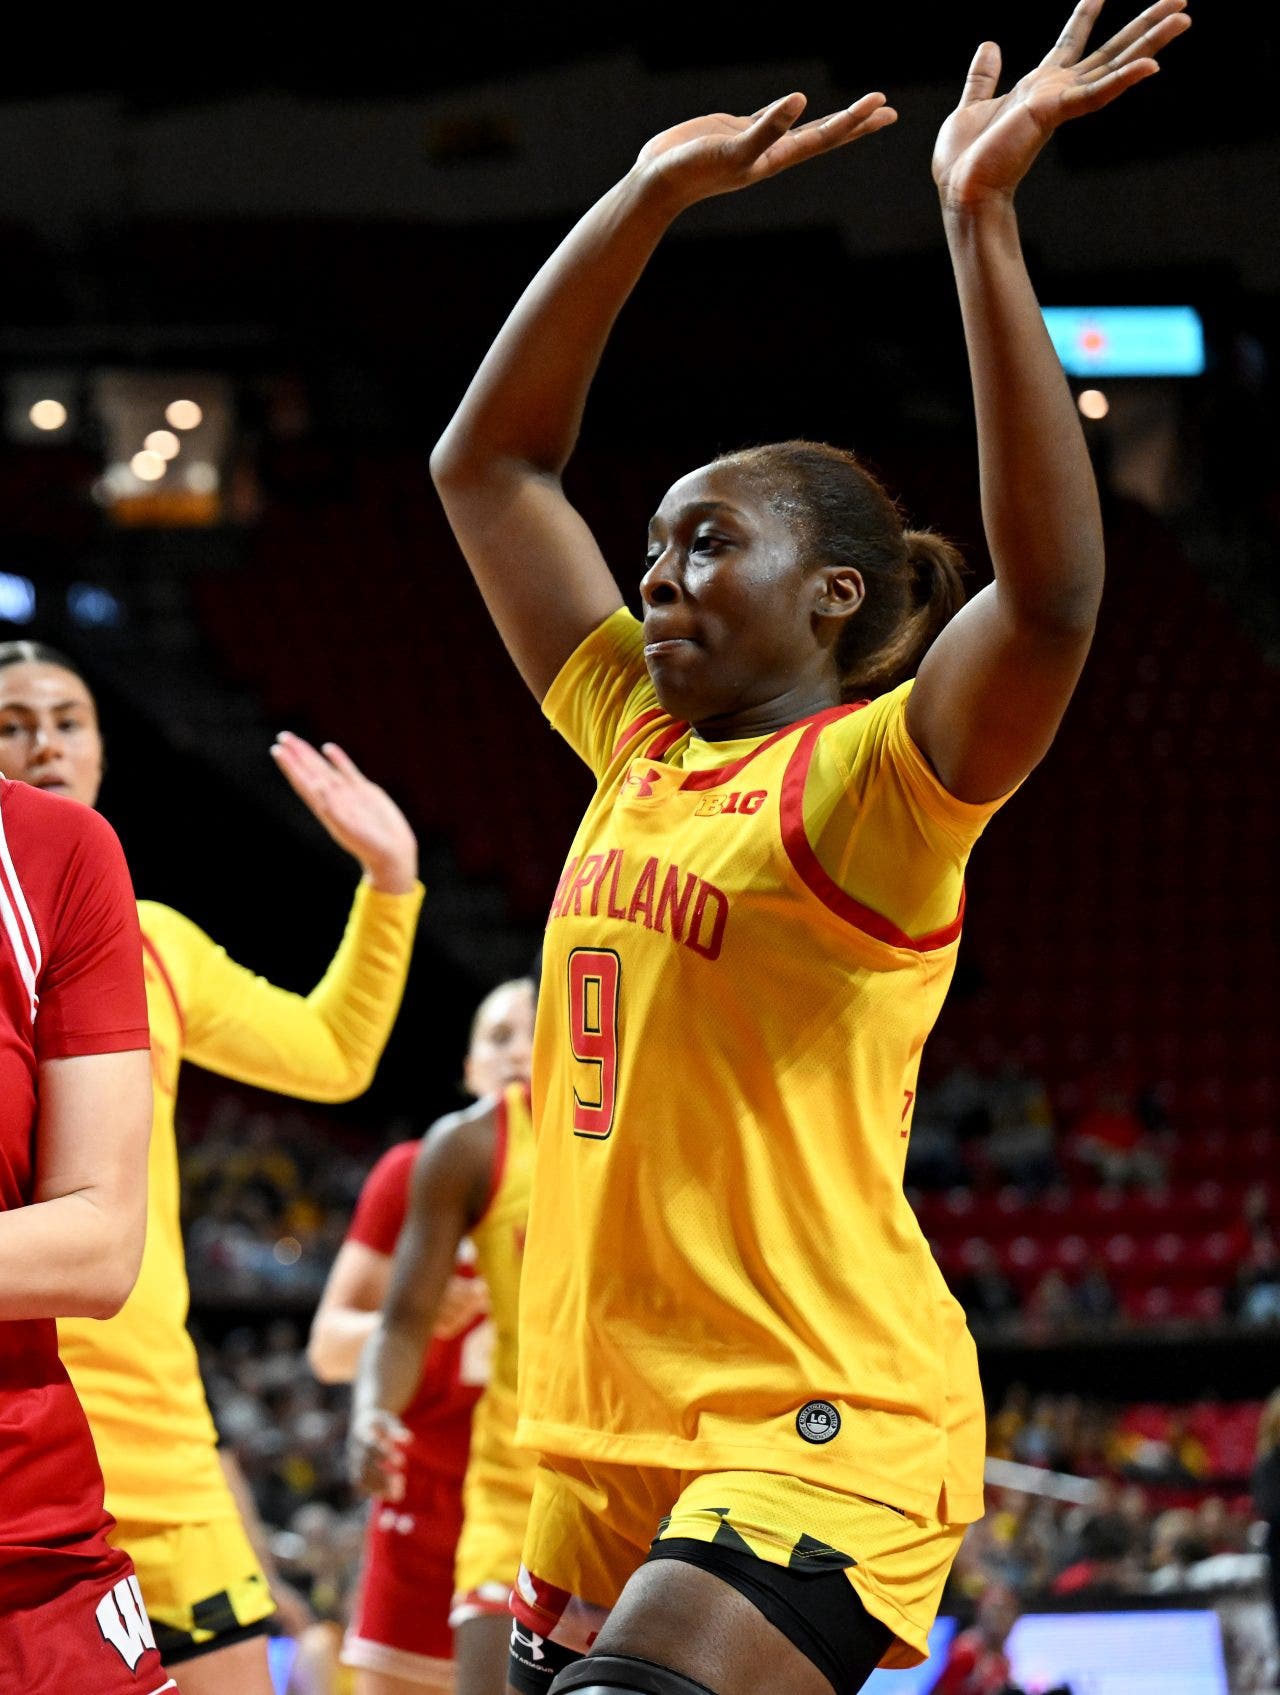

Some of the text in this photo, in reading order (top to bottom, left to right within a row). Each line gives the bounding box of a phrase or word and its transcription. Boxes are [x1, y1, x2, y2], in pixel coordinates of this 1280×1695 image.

[546, 848, 730, 962] ARYLAND
[566, 946, 621, 1141] 9
[810, 1413, 827, 1424] LG
[95, 1574, 157, 1674] W
